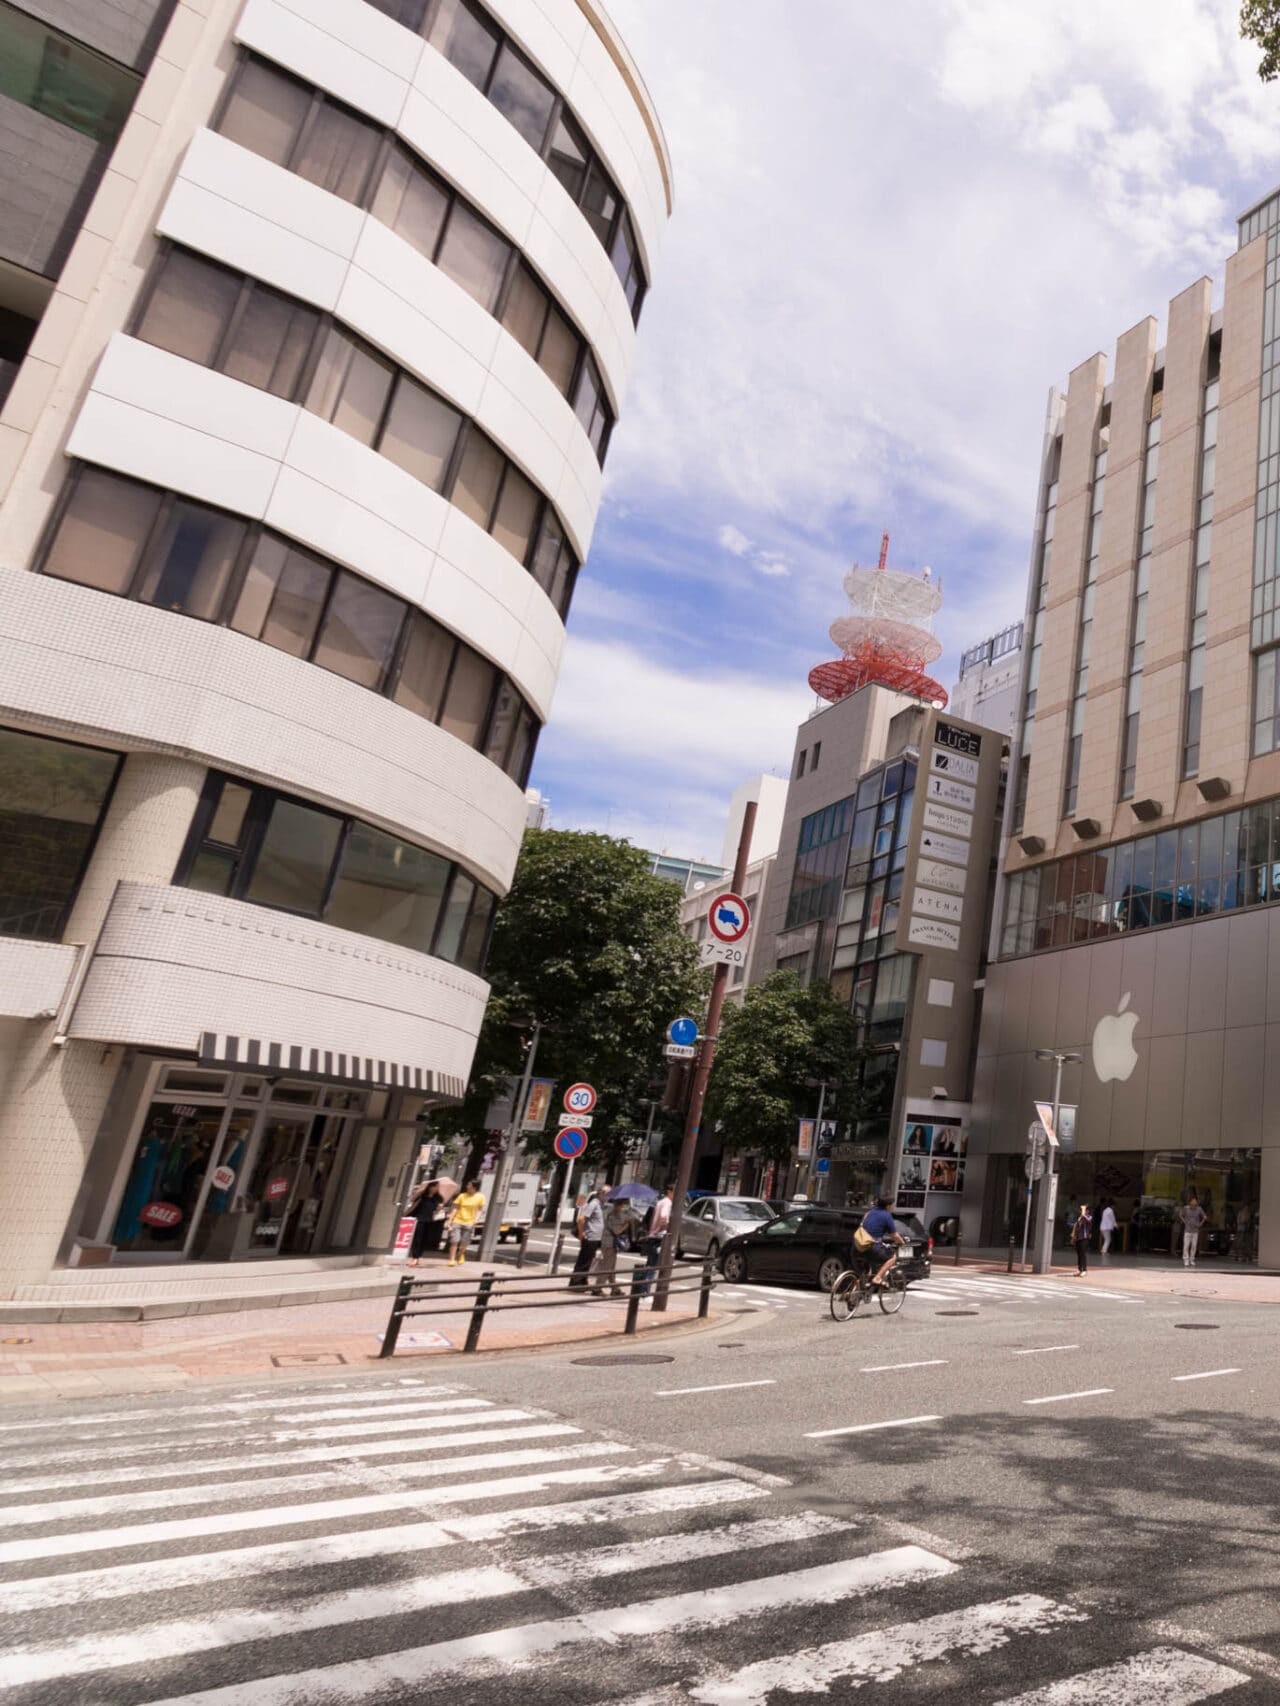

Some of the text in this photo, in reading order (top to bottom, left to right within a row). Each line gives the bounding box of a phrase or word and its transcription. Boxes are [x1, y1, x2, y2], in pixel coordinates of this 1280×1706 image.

[938, 729, 978, 754] LUCE
[571, 1092, 589, 1106] 30
[147, 1206, 177, 1223] SALE
